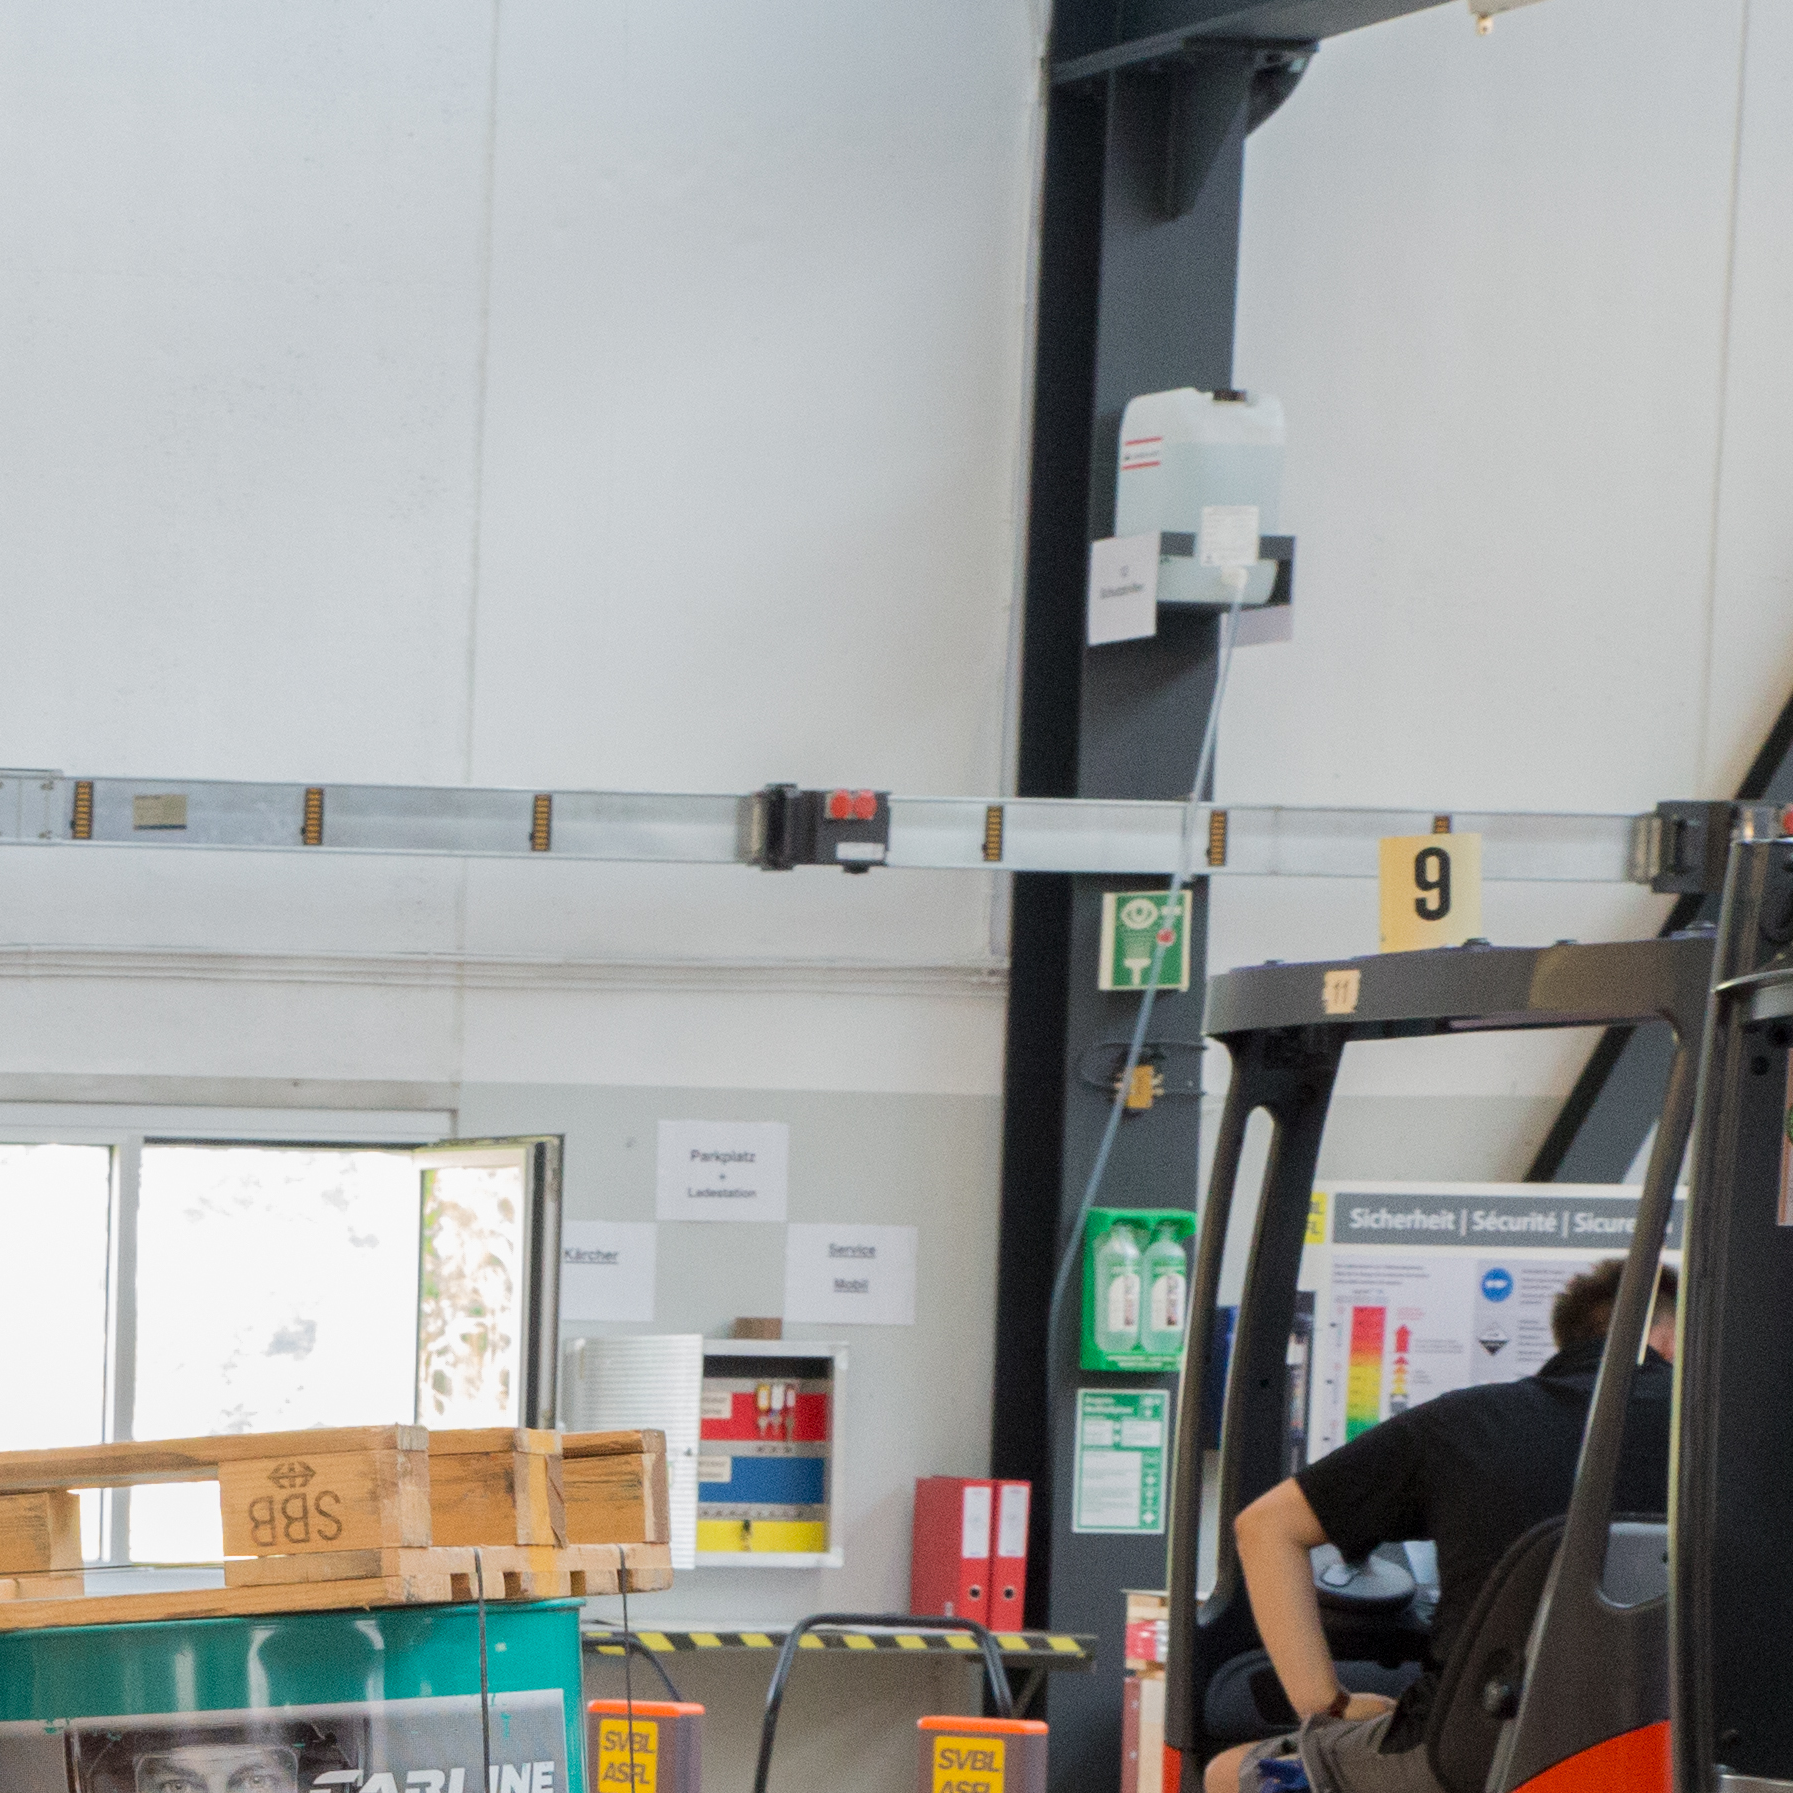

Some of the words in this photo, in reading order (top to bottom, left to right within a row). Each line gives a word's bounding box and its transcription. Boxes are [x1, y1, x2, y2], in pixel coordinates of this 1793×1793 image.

[1414, 847, 1451, 921] 9
[690, 1150, 756, 1165] Parkplatz
[687, 1186, 756, 1199] Ladestation
[1349, 1207, 1456, 1231] Sicherheit
[1473, 1208, 1557, 1232] Sécurité
[564, 1248, 618, 1262] Kärcher
[828, 1243, 876, 1257] Service
[833, 1277, 869, 1292] Mobil
[248, 1489, 342, 1547] SBB
[602, 1730, 655, 1755] SVBL
[938, 1748, 1001, 1773] SVBL
[602, 1761, 651, 1786] ASFL
